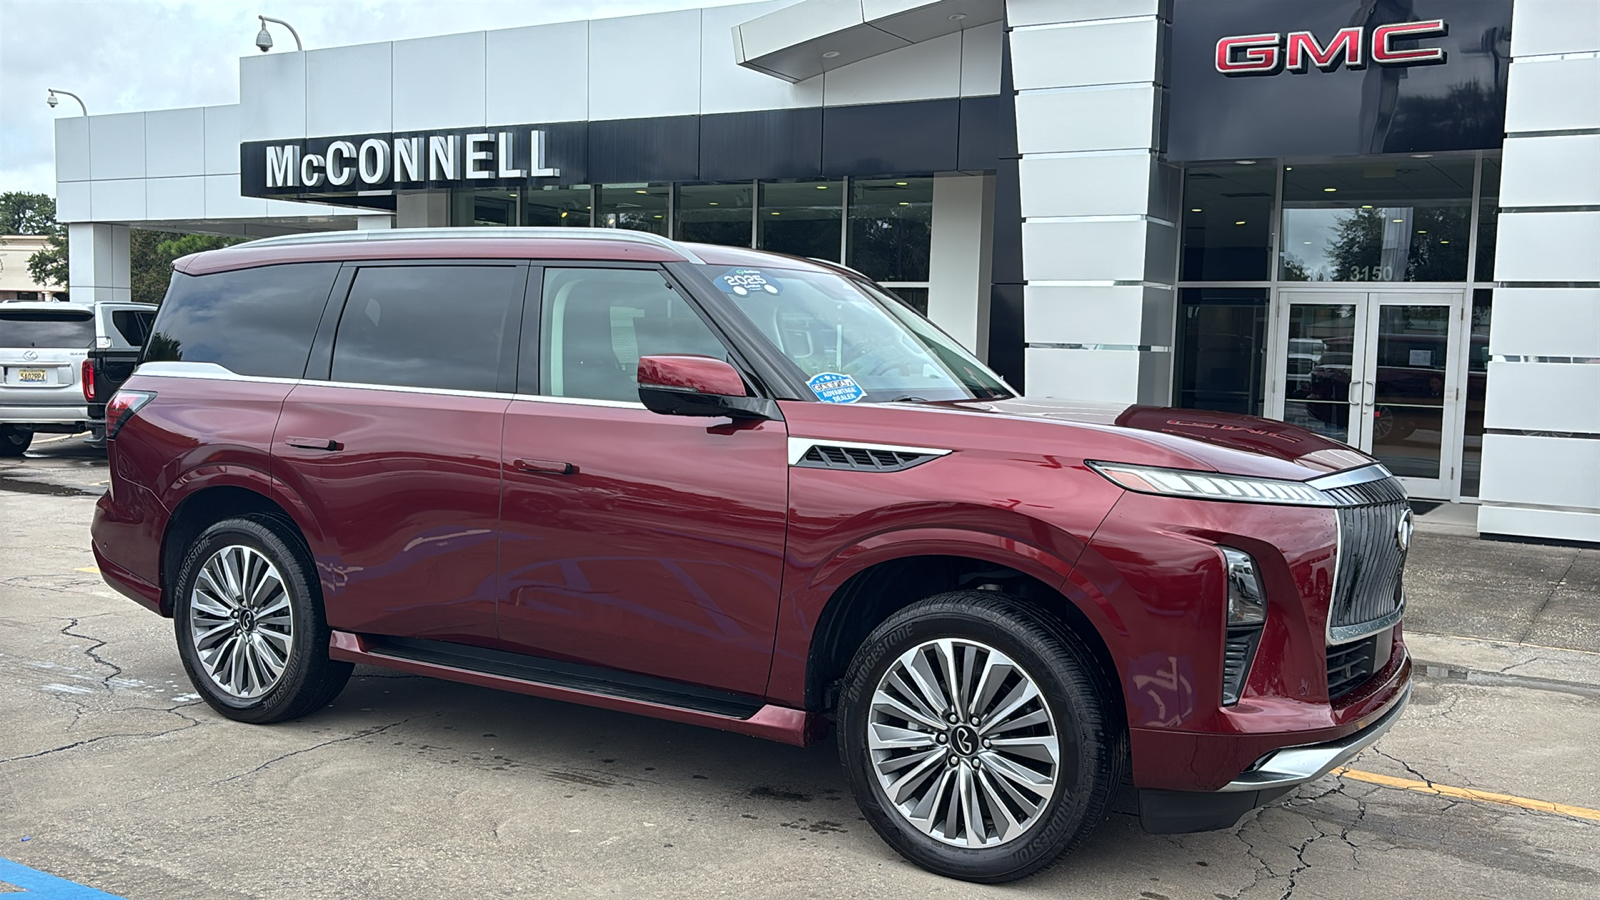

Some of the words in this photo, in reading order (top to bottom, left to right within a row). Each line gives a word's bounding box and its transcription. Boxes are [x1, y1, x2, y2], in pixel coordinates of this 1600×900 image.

[1215, 19, 1447, 75] GMC
[266, 130, 560, 187] McCONNELL
[723, 274, 767, 286] 2025
[1350, 265, 1393, 281] 3150
[176, 536, 212, 598] BRIDGESTONE
[847, 622, 914, 702] BRIDGESTONE
[1011, 788, 1076, 863] BRIDGESTON
